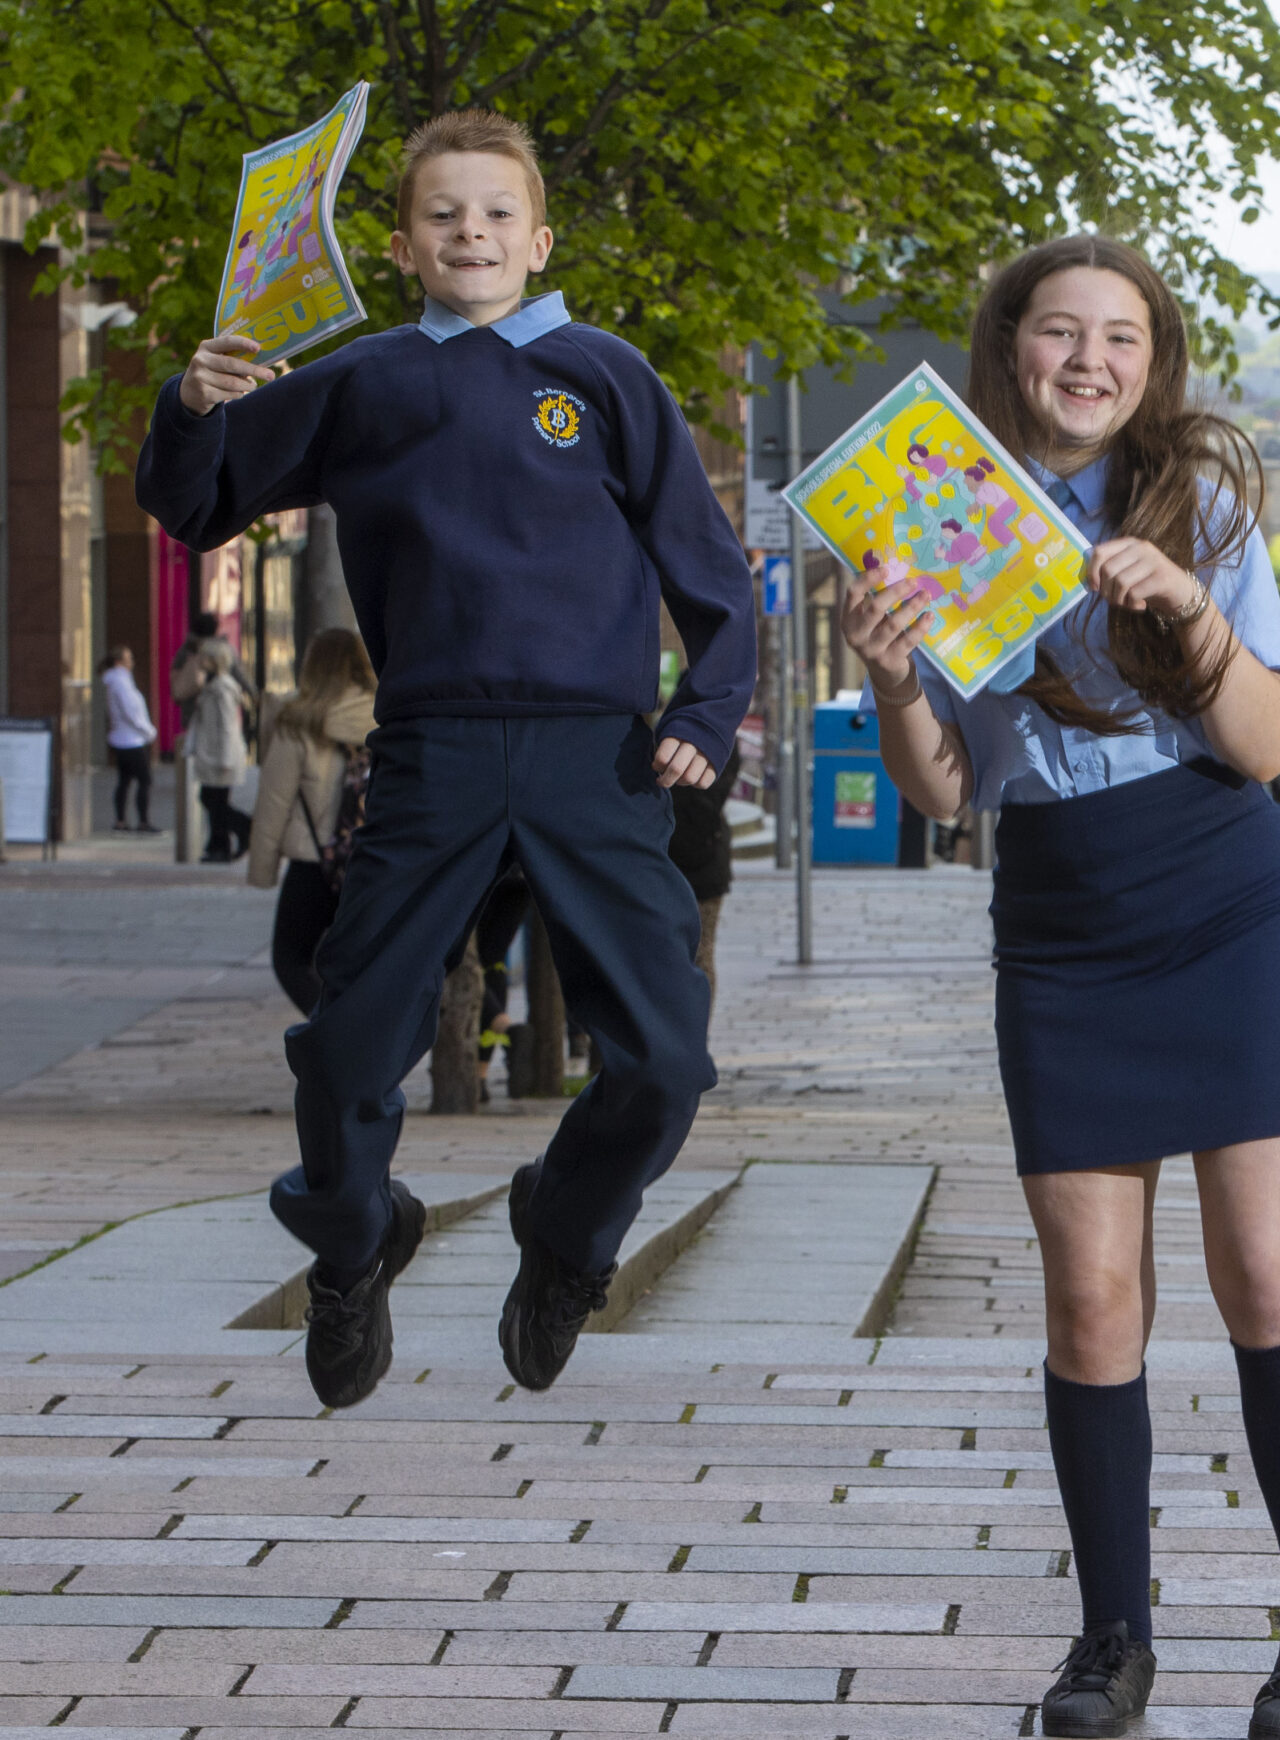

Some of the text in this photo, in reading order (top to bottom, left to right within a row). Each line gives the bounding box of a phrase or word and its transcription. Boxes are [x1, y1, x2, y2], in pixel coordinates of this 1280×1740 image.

[241, 112, 345, 218] BIG
[531, 416, 580, 448] Primary School
[546, 388, 586, 412] Bernard's
[804, 400, 967, 546] BIG
[819, 455, 846, 481] SPECIAL
[841, 434, 869, 461] EDITION
[863, 420, 883, 441] 2022
[947, 549, 1084, 686] ISSUE
